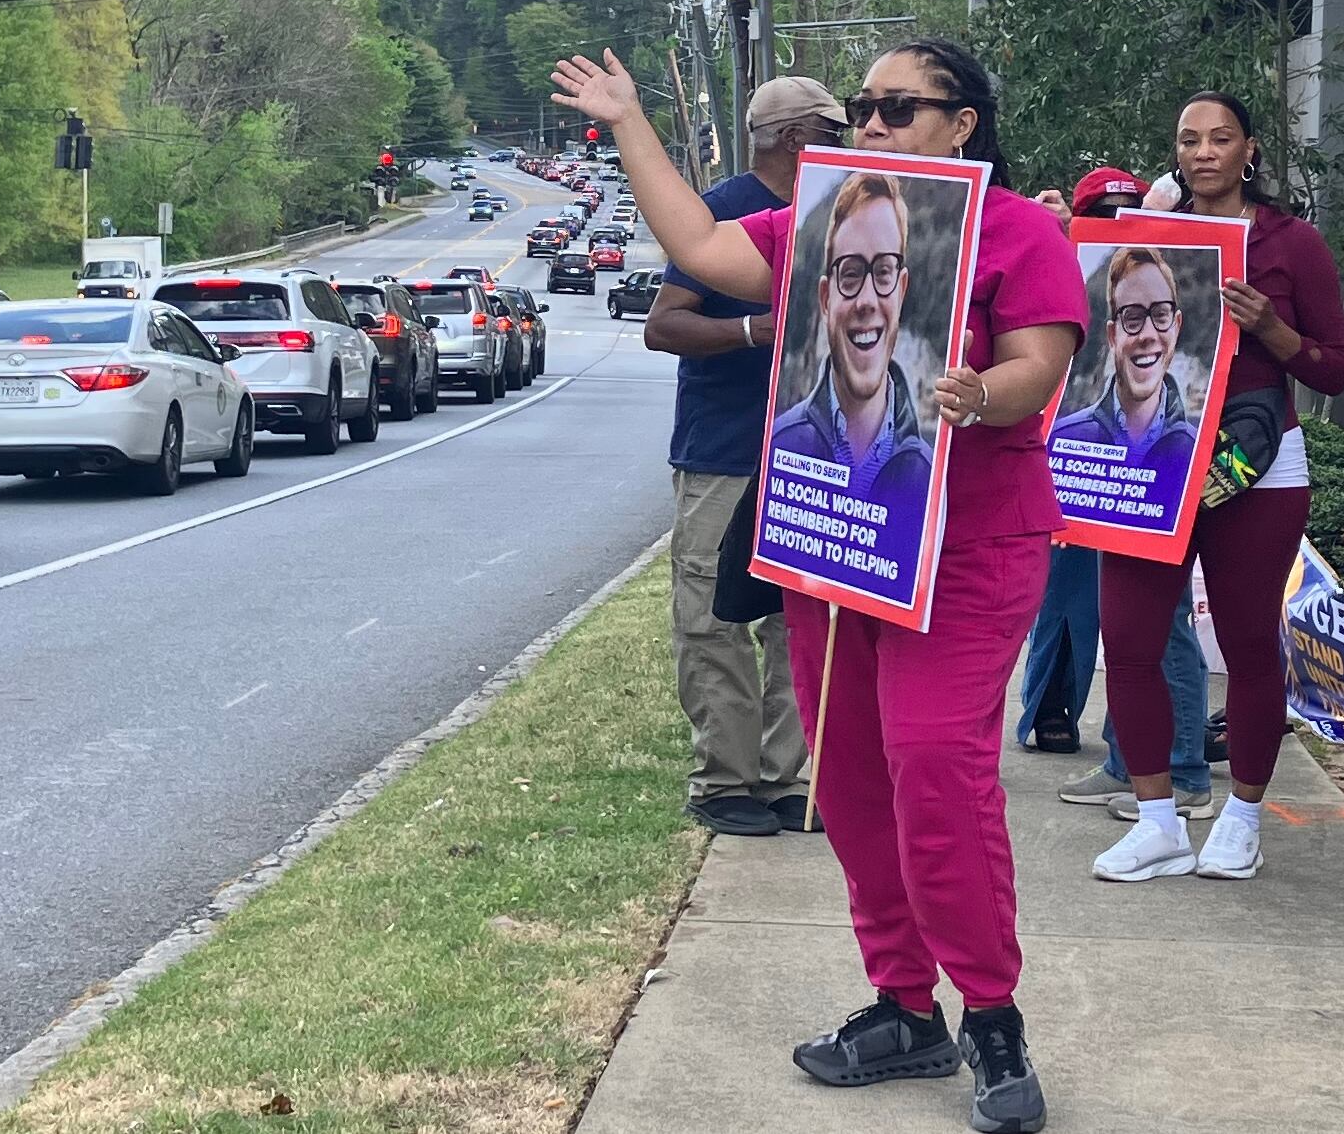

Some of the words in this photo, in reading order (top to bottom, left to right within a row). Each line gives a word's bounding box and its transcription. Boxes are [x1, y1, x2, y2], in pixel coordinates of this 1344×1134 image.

[775, 454, 781, 464] A
[781, 455, 811, 471] CALLING
[812, 462, 822, 474] TO
[823, 466, 847, 482] SERVE
[1052, 473, 1122, 495] EMEMBERED
[1123, 484, 1147, 499] FOR
[1064, 459, 1106, 477] SOCIAL
[1109, 465, 1157, 483] WORKER
[771, 476, 785, 498] VA
[786, 481, 830, 510] SOCIAL
[832, 493, 888, 526] WORKER
[1054, 489, 1097, 508] VOTION
[1098, 496, 1116, 511] TO
[1115, 499, 1164, 518] HELPING
[767, 499, 849, 539] REMEMBERED
[849, 523, 877, 548] FOR
[764, 523, 824, 558] DEVOTION
[824, 541, 843, 563] TO
[843, 547, 899, 580] HELPING
[1292, 627, 1344, 676] STAND
